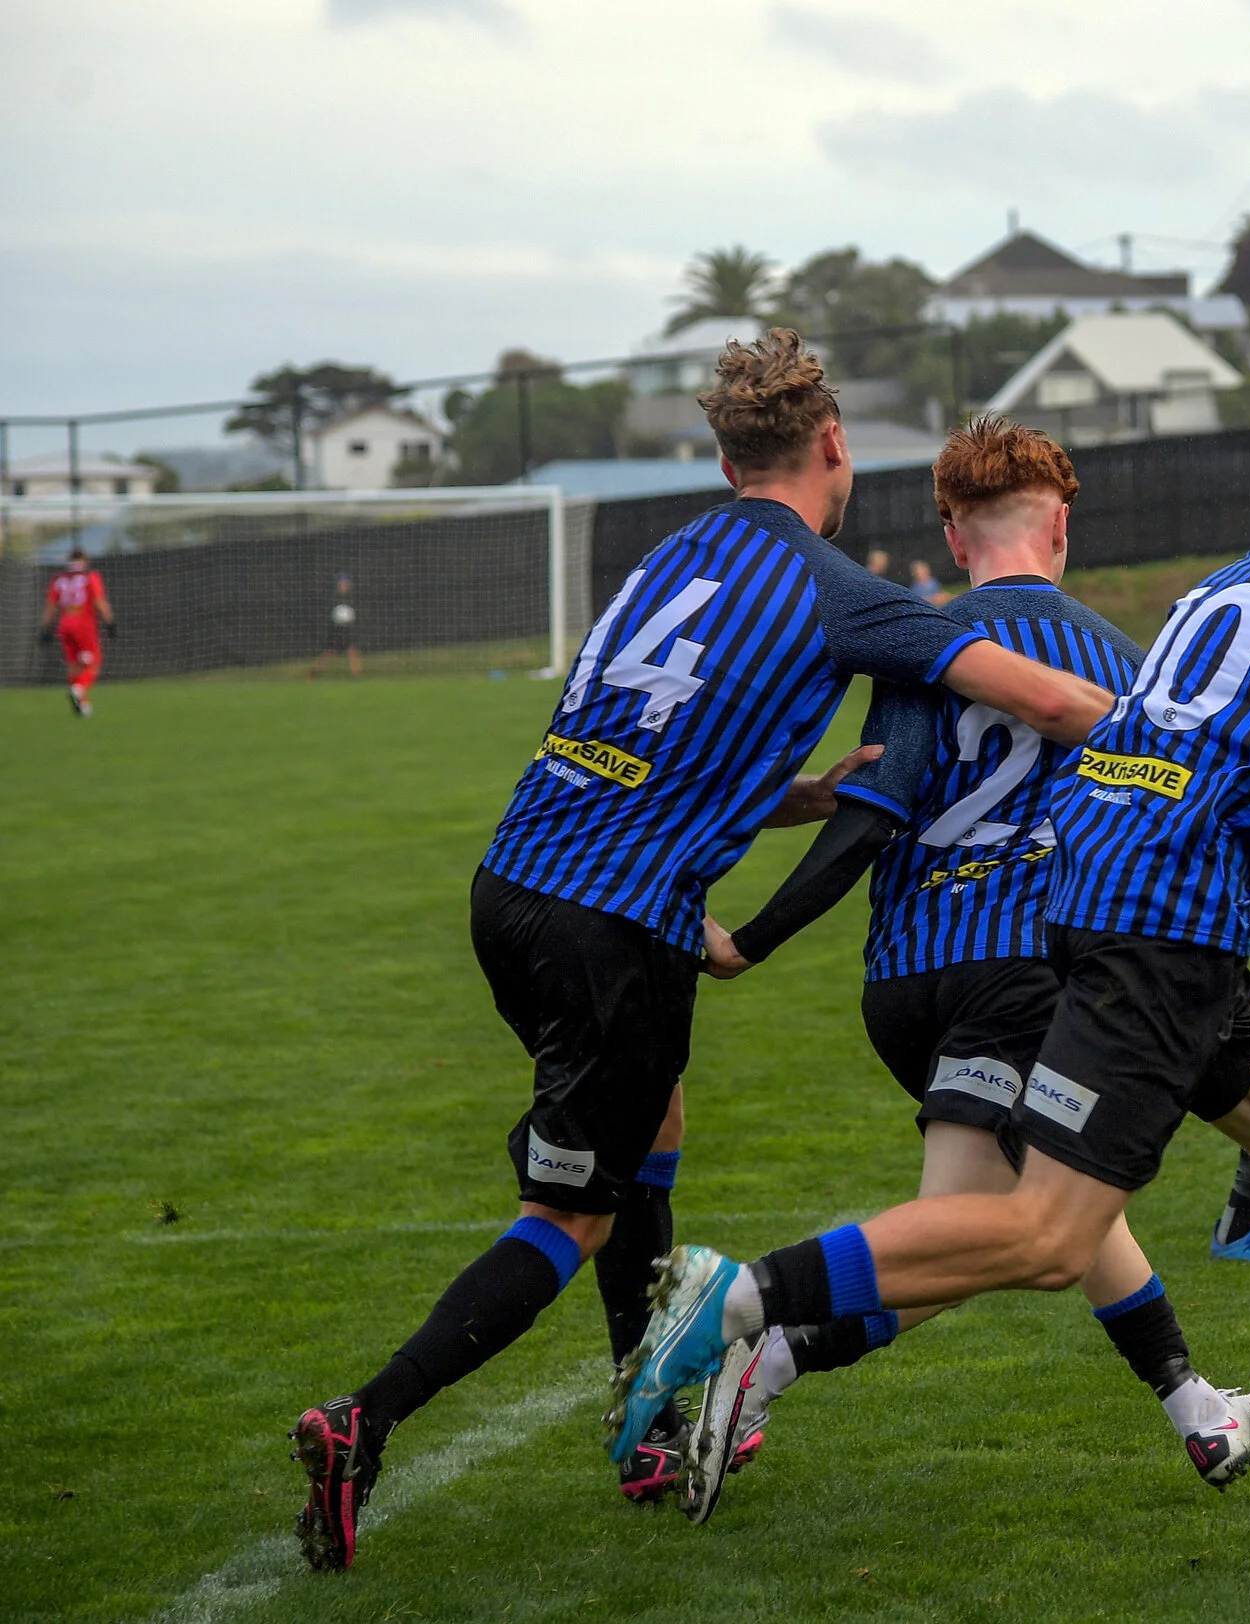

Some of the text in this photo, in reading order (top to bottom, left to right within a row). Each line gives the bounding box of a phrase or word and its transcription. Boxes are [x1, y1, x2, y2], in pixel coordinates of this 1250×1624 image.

[562, 569, 722, 732] 14
[918, 702, 1057, 847] 2
[956, 1067, 1018, 1095] OAKS
